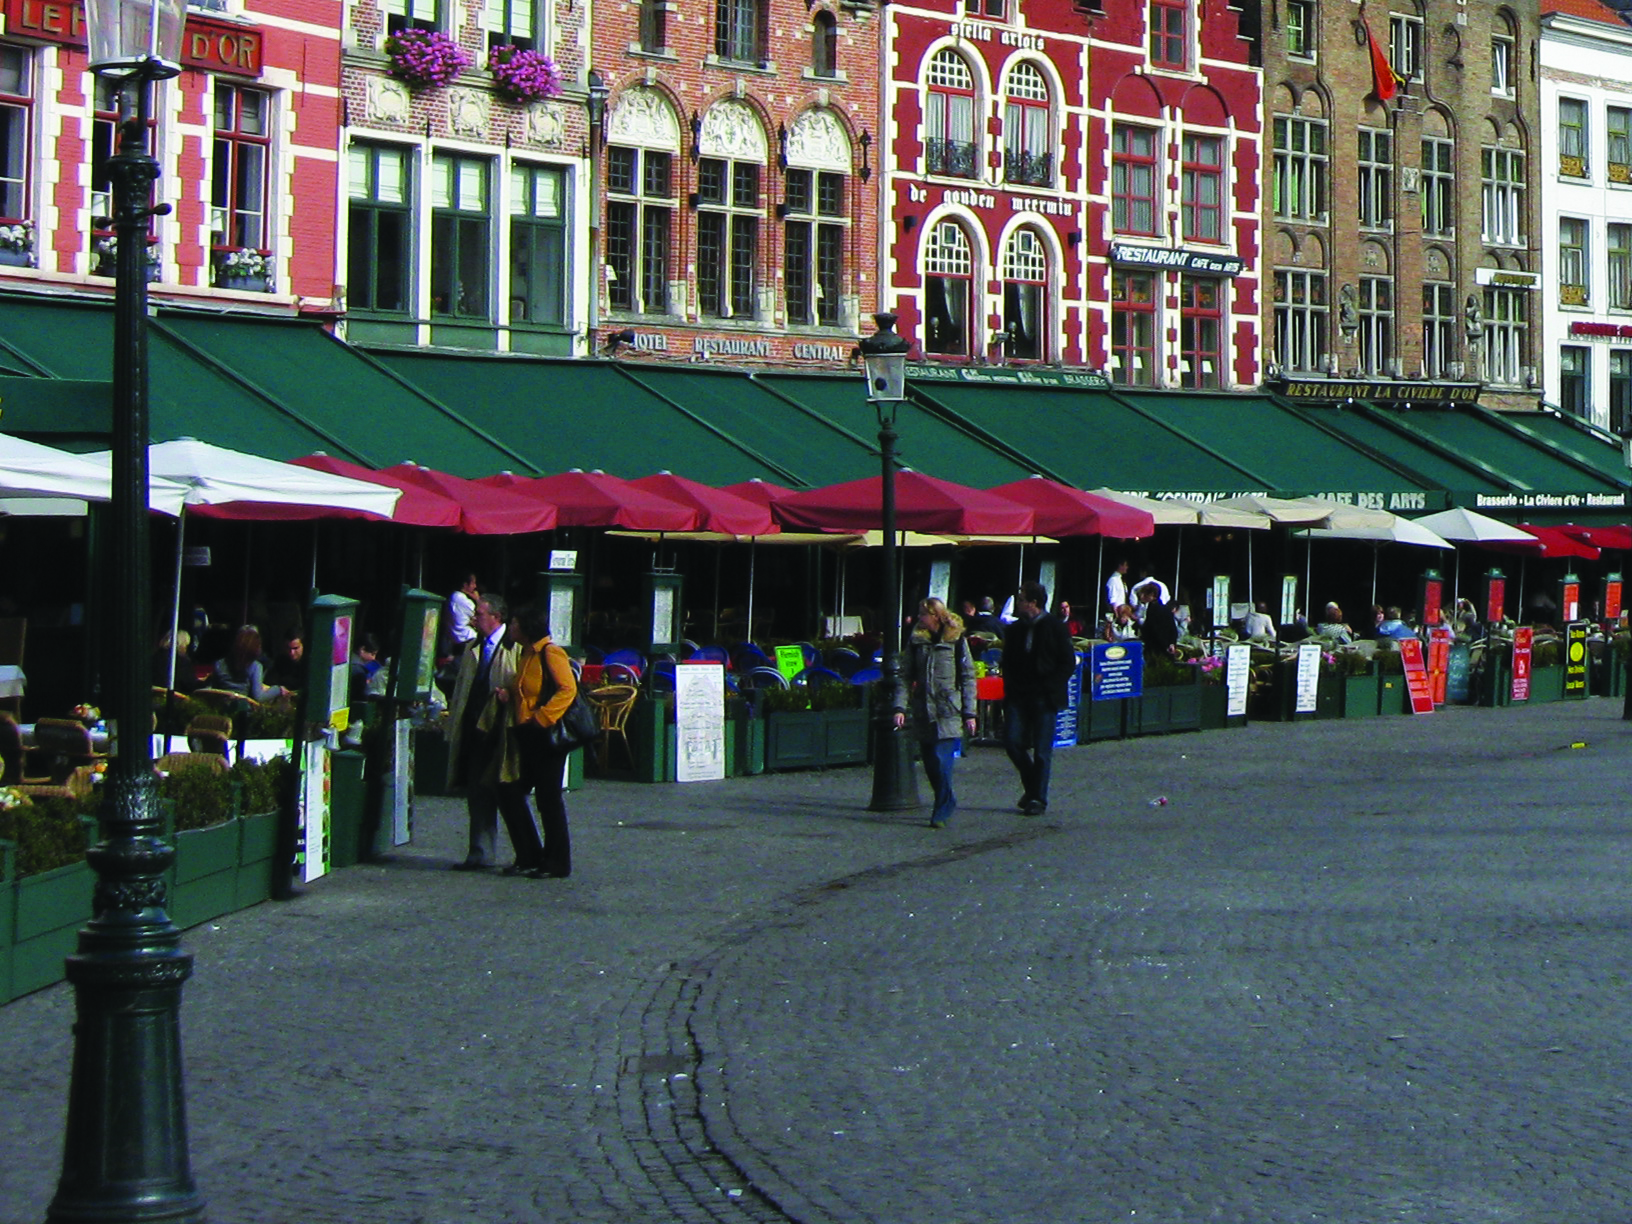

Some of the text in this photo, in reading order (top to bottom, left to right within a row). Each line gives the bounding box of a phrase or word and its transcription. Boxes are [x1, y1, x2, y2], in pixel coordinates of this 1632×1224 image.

[22, 0, 63, 34] LE
[190, 31, 256, 69] D'OR
[951, 22, 1045, 51] stella artois
[909, 182, 1073, 217] de gouden meermin
[1117, 245, 1190, 266] RESTAURANT
[694, 337, 773, 358] RESTAURANT
[793, 342, 844, 361] CENTRAL
[1285, 383, 1371, 398] RESTAURANT
[1374, 385, 1392, 399] LA
[1450, 387, 1478, 401] D'OR
[1358, 492, 1385, 510] DES
[1389, 492, 1426, 510] ARTS
[1476, 493, 1518, 507] Brasserie
[1524, 494, 1535, 507] La
[1586, 492, 1625, 506] Restaurant
